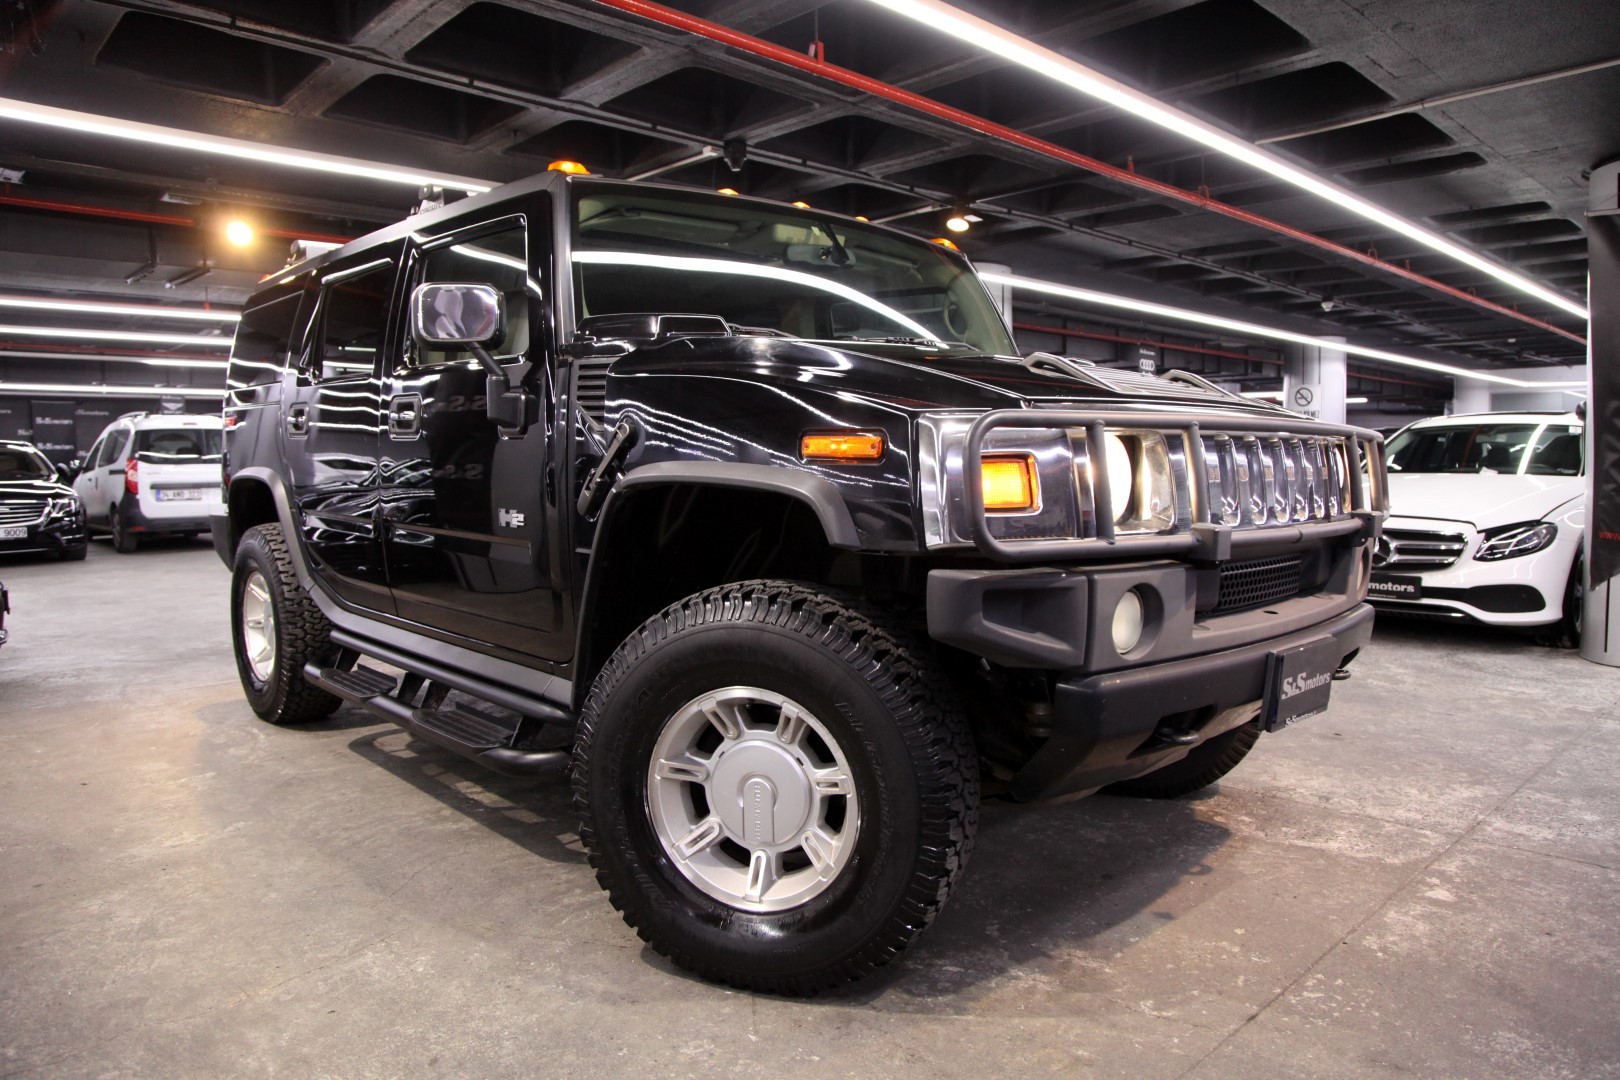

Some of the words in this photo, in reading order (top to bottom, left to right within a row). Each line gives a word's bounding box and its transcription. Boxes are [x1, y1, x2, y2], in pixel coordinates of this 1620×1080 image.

[498, 507, 525, 529] H2
[3, 528, 27, 537] 9009
[1281, 672, 1331, 700] S&Smotors
